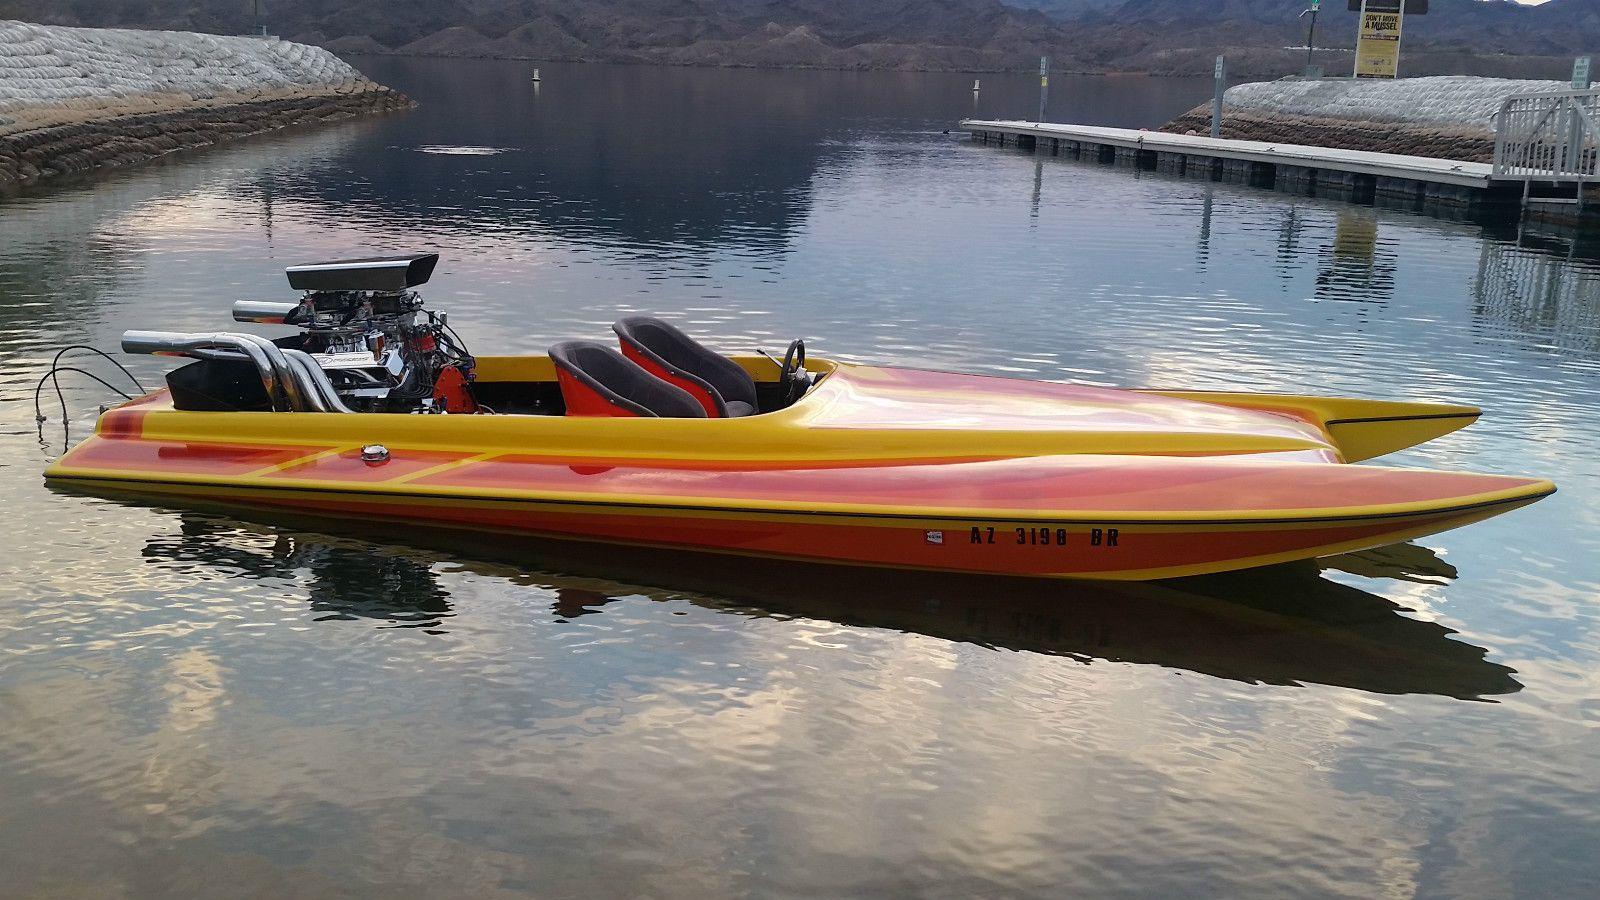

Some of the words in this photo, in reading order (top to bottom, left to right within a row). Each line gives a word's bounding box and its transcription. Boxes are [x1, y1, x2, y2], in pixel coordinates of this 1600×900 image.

[1365, 21, 1370, 29] A
[1372, 22, 1397, 30] MUSSEL
[971, 527, 996, 544] AZ
[1090, 529, 1119, 546] BR
